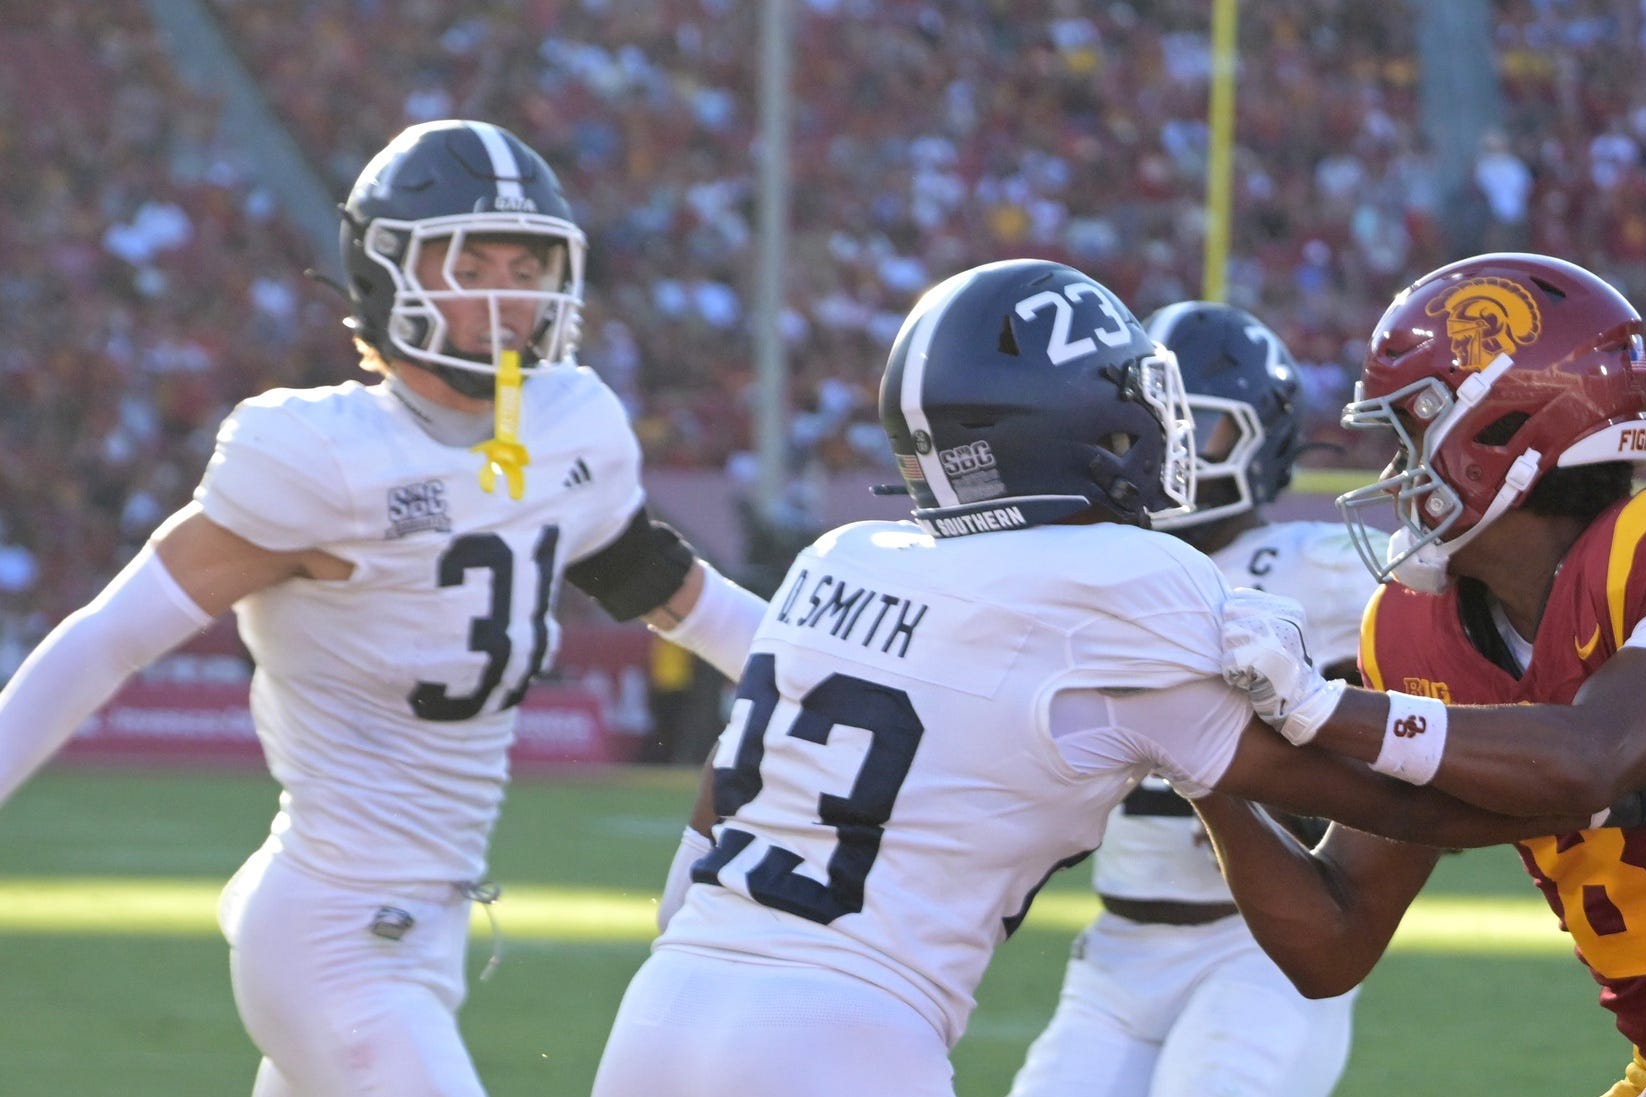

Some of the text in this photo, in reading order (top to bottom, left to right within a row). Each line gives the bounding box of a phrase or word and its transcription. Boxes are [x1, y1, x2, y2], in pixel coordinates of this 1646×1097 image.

[1014, 282, 1131, 366] 23
[940, 440, 996, 477] SBC
[936, 506, 1028, 537] SOUTHERN
[1248, 547, 1279, 576] C
[407, 524, 560, 722] 31
[691, 652, 925, 926] 23
